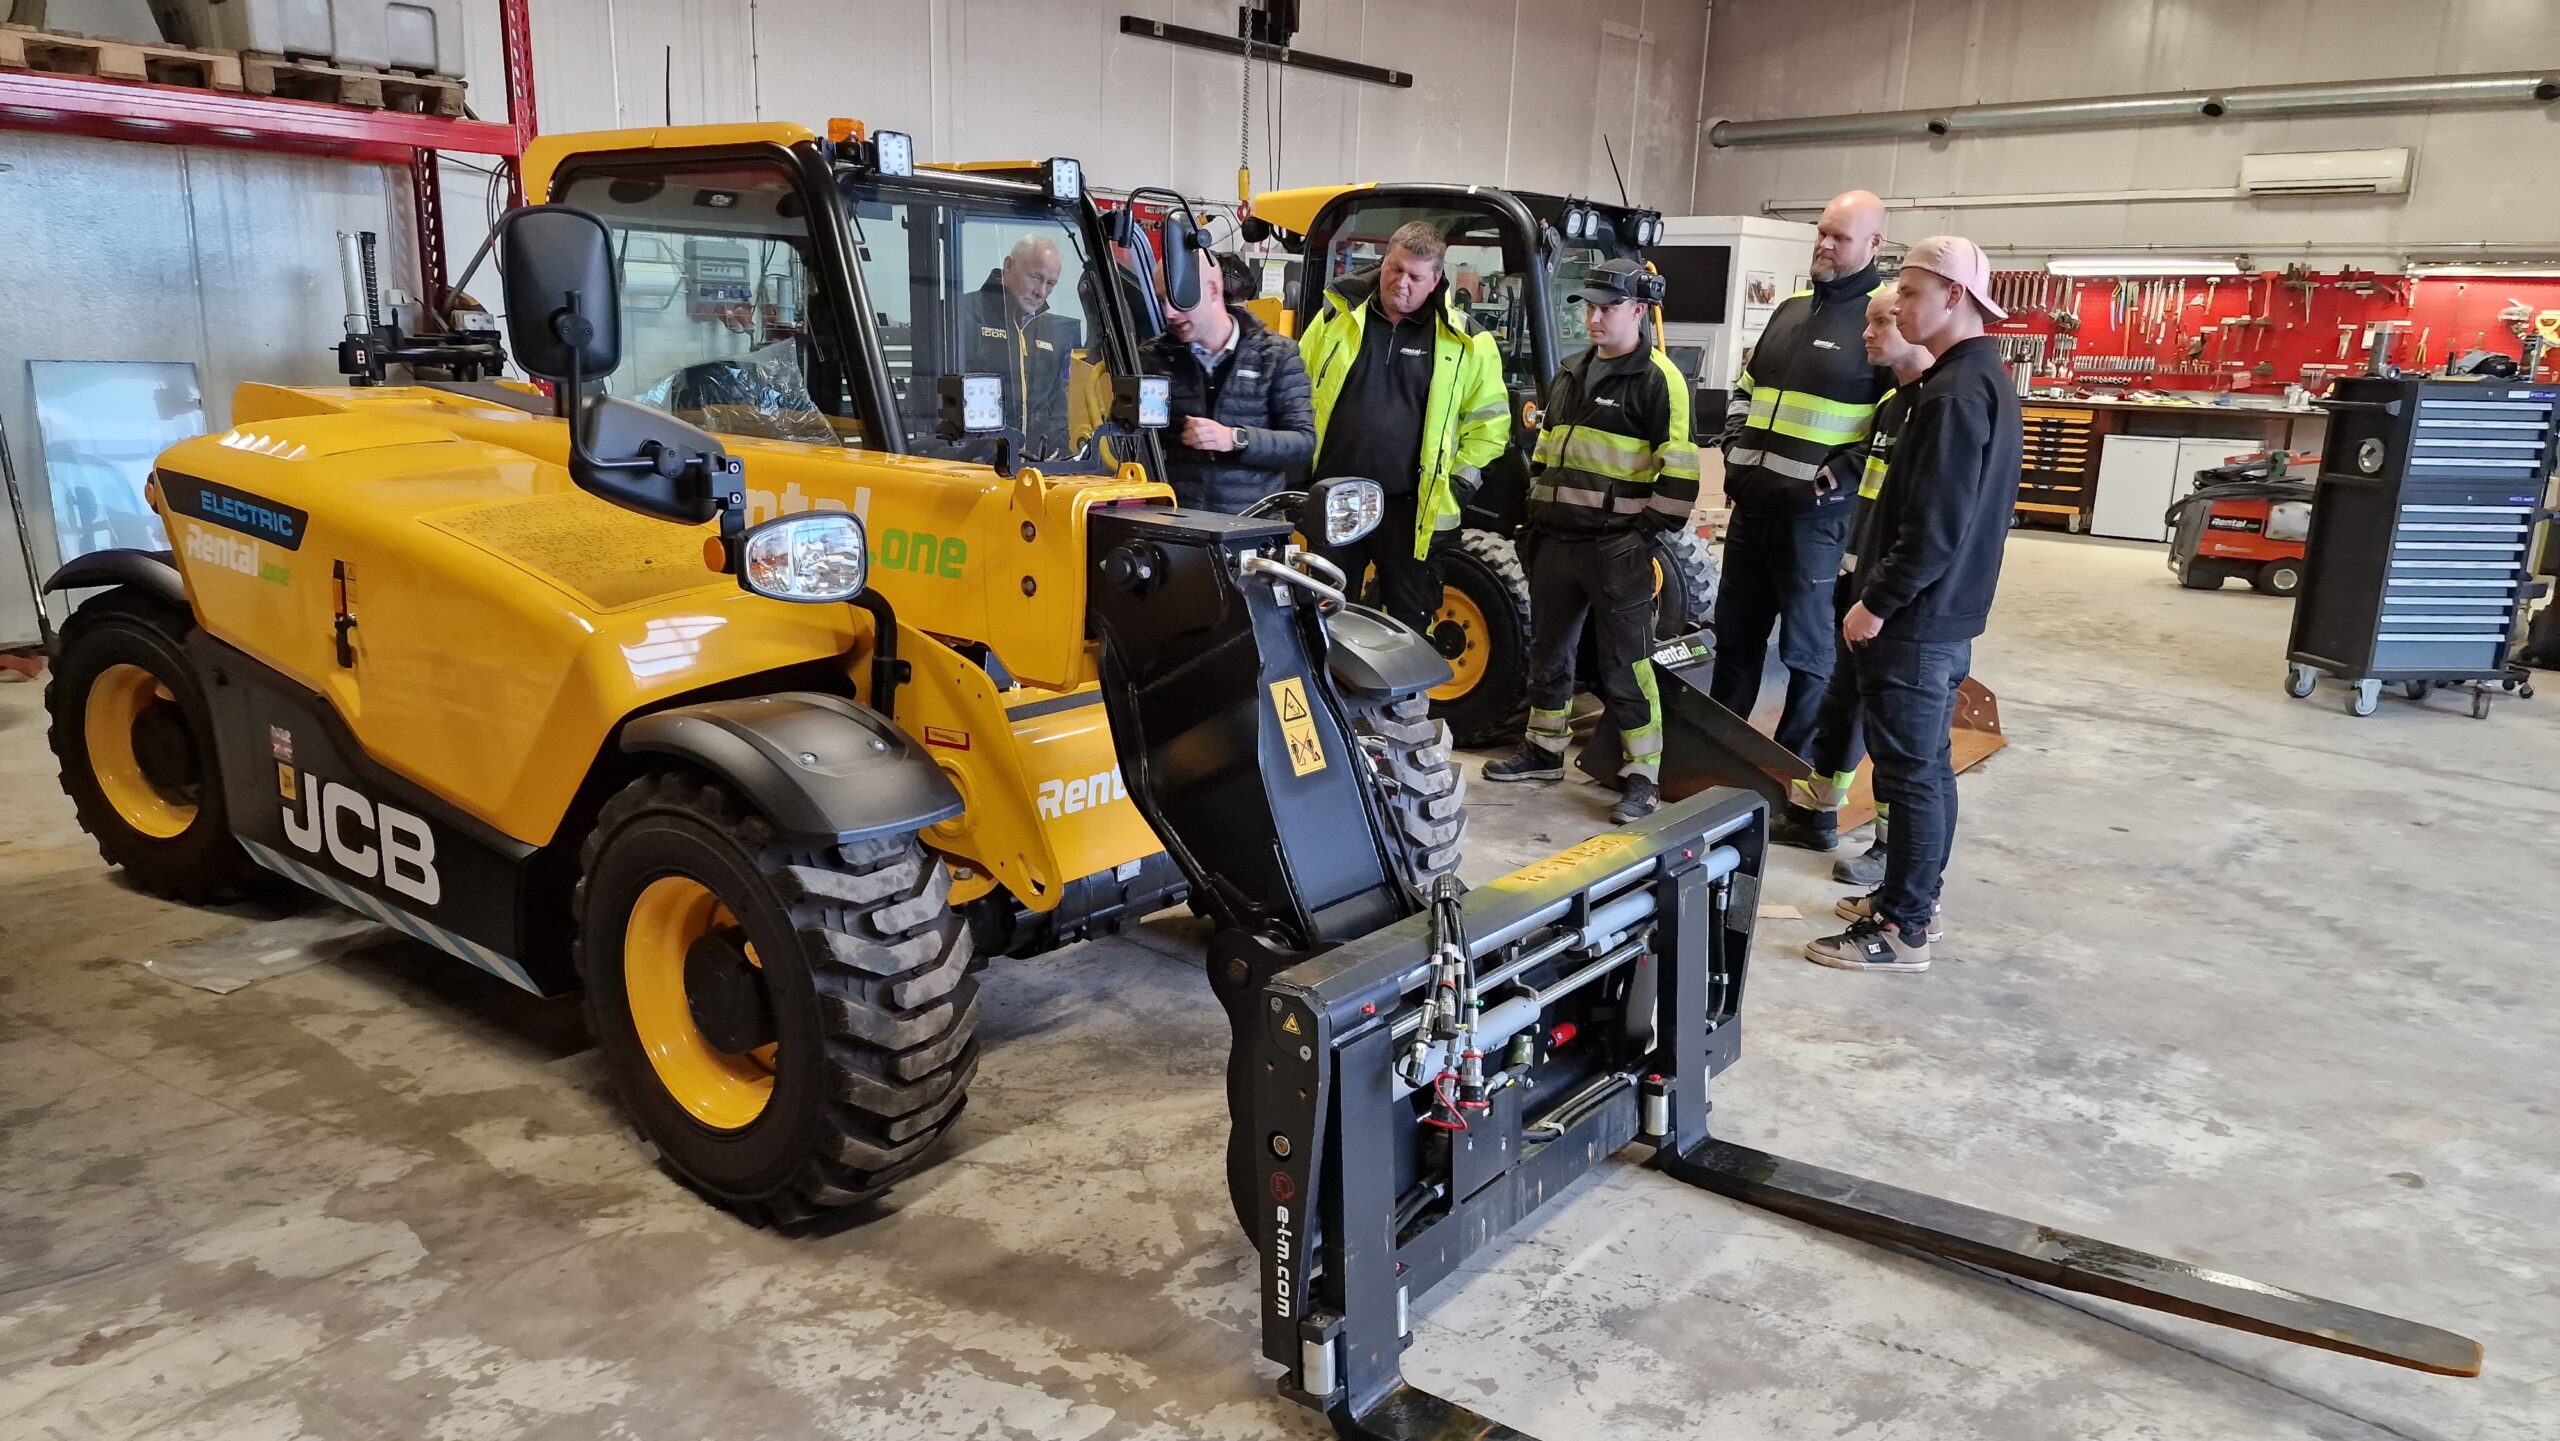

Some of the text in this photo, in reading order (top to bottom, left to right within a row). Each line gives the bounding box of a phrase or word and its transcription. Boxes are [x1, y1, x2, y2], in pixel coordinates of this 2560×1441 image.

[200, 489, 294, 537] ELECTRIC
[1037, 762, 1128, 821] Rent
[282, 771, 441, 906] JCB
[1276, 1204, 1293, 1319] e-l-m.com
